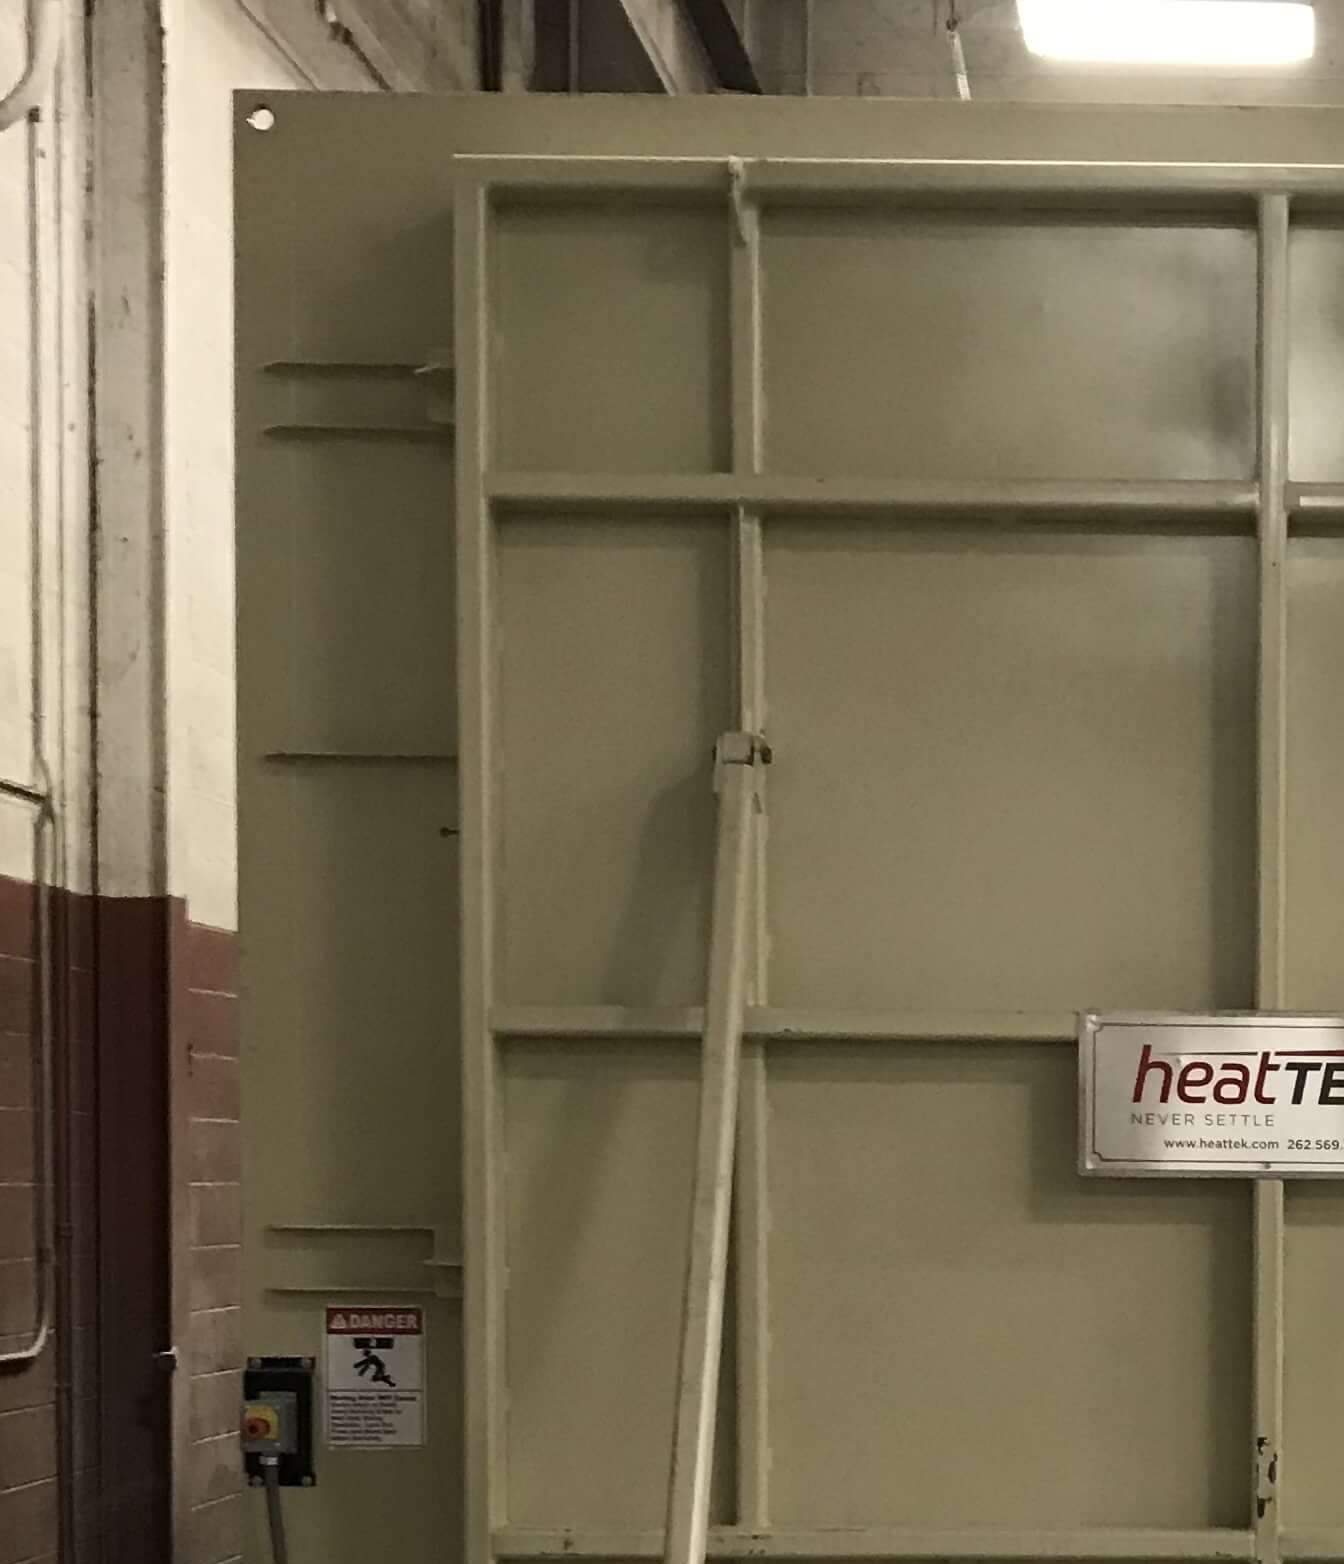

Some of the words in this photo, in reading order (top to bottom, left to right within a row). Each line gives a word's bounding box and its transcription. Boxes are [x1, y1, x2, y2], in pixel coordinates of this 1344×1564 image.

[1131, 1113, 1195, 1126] NEVER
[1204, 1113, 1275, 1127] SETTLE
[1163, 1138, 1279, 1150] www.heattek.com
[350, 1314, 418, 1329] DANGER
